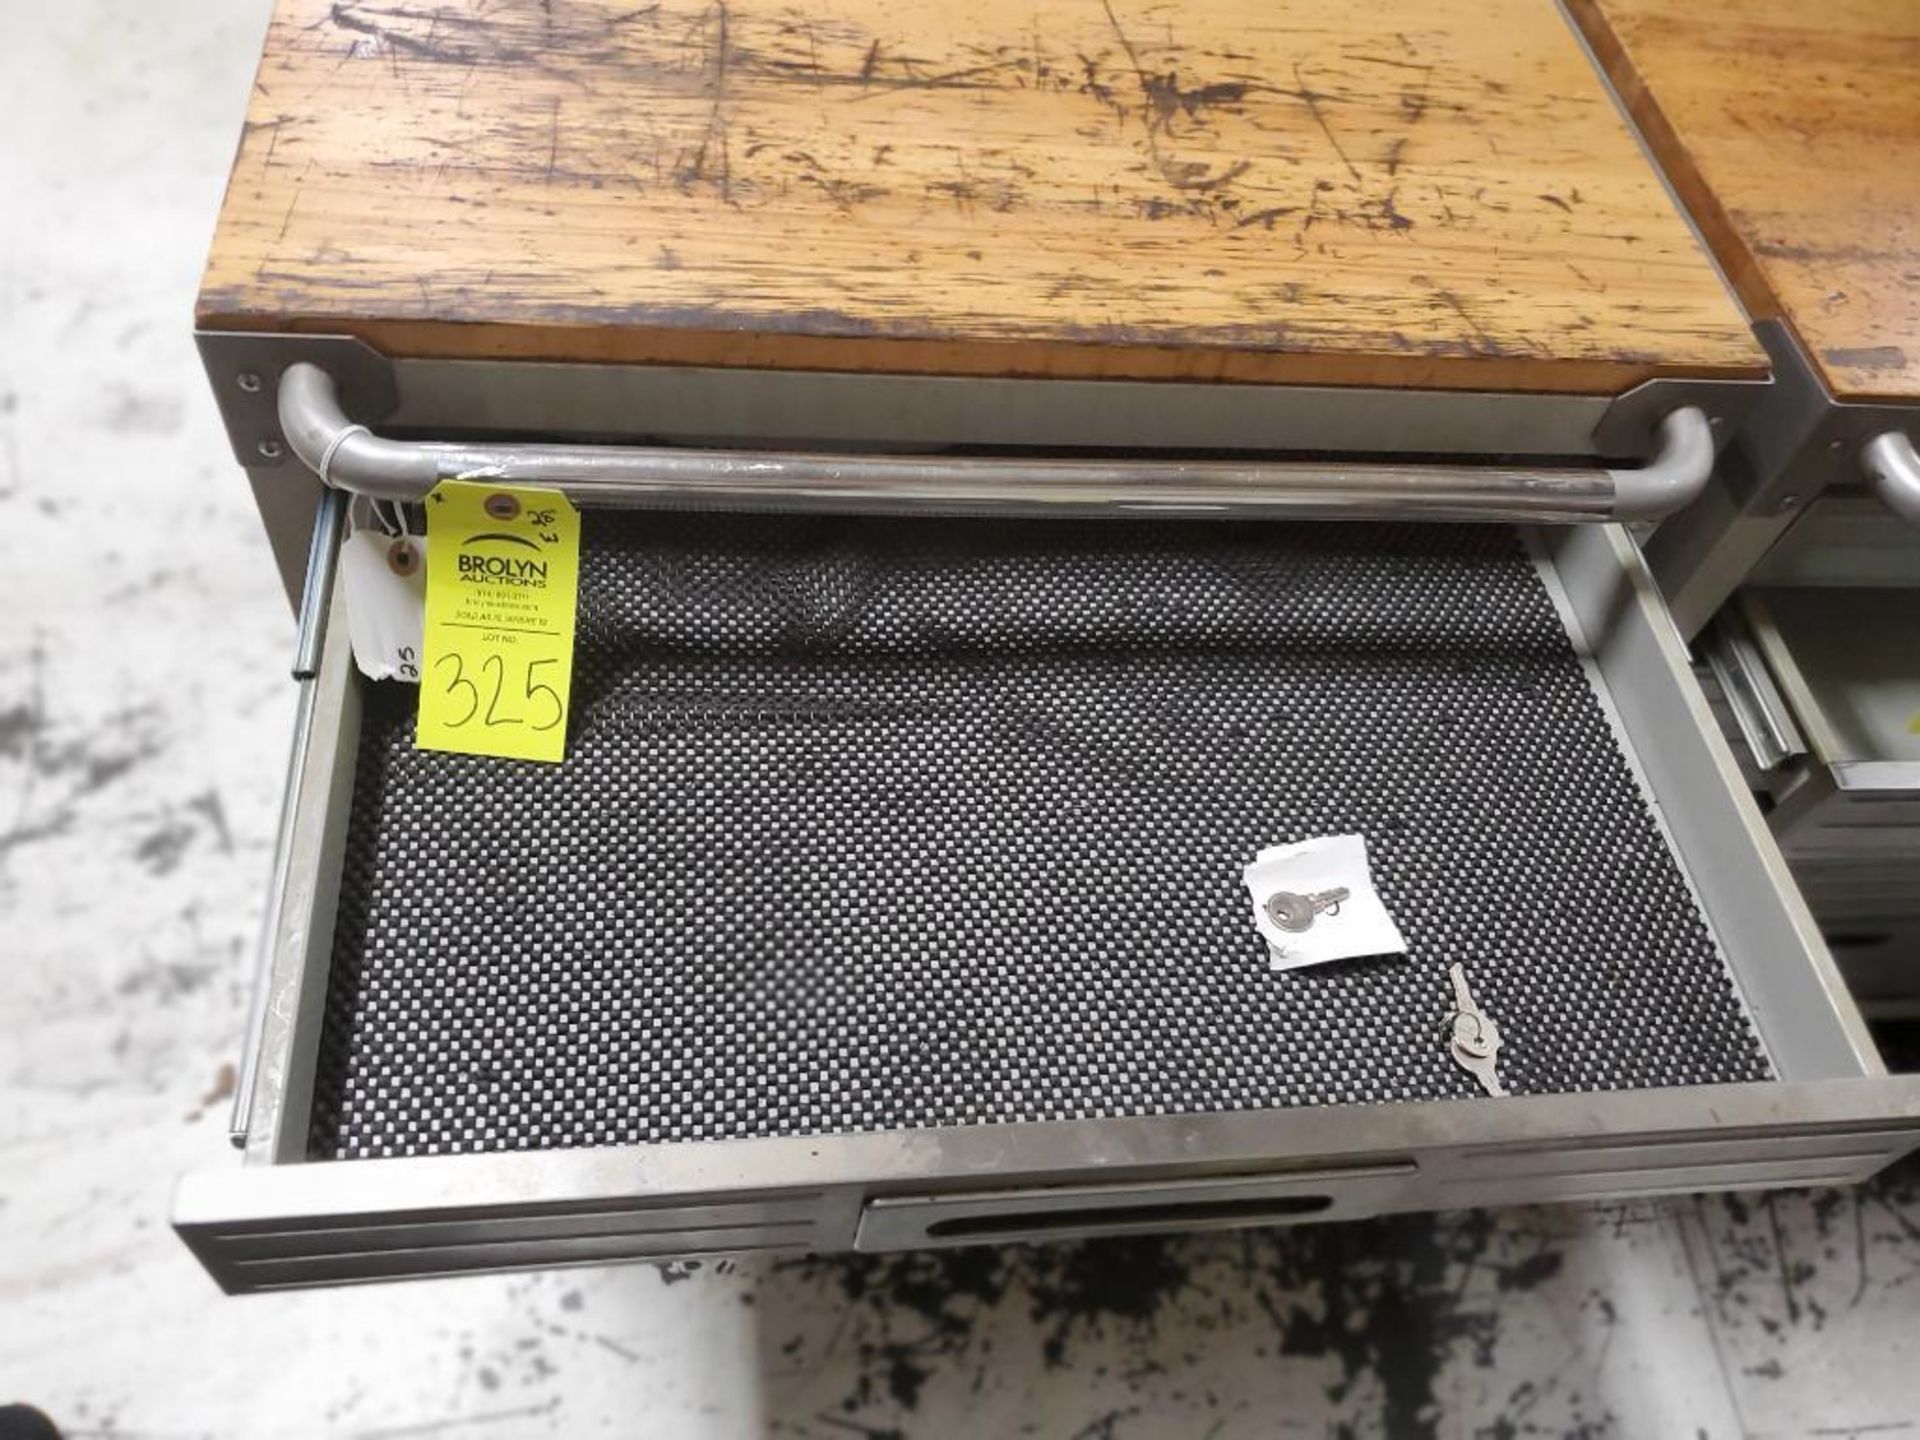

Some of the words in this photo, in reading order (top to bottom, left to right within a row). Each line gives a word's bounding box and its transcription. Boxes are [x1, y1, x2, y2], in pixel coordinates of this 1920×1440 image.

[458, 554, 547, 579] BROLYN
[460, 574, 547, 588] AUCTIONS
[434, 653, 564, 731] 325
